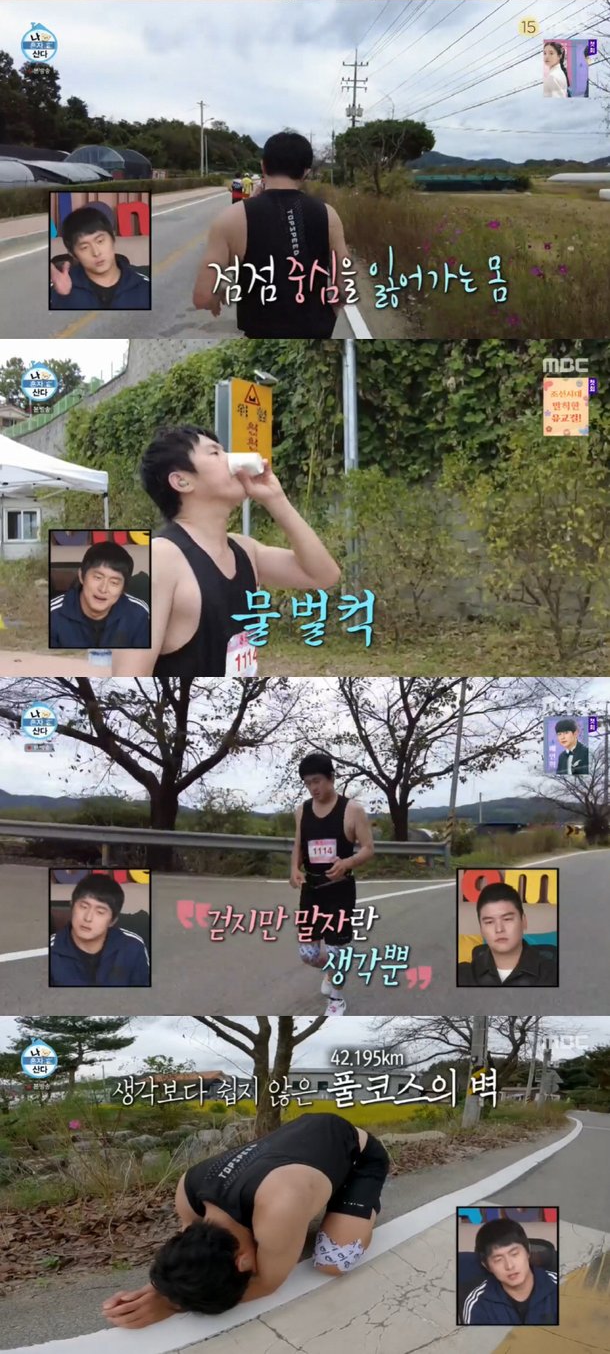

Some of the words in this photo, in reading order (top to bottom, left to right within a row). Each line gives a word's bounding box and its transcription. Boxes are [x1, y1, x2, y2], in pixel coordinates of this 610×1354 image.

[286, 208, 300, 256] TOPSPEED
[234, 646, 258, 672] 1114
[313, 847, 333, 855] 1114
